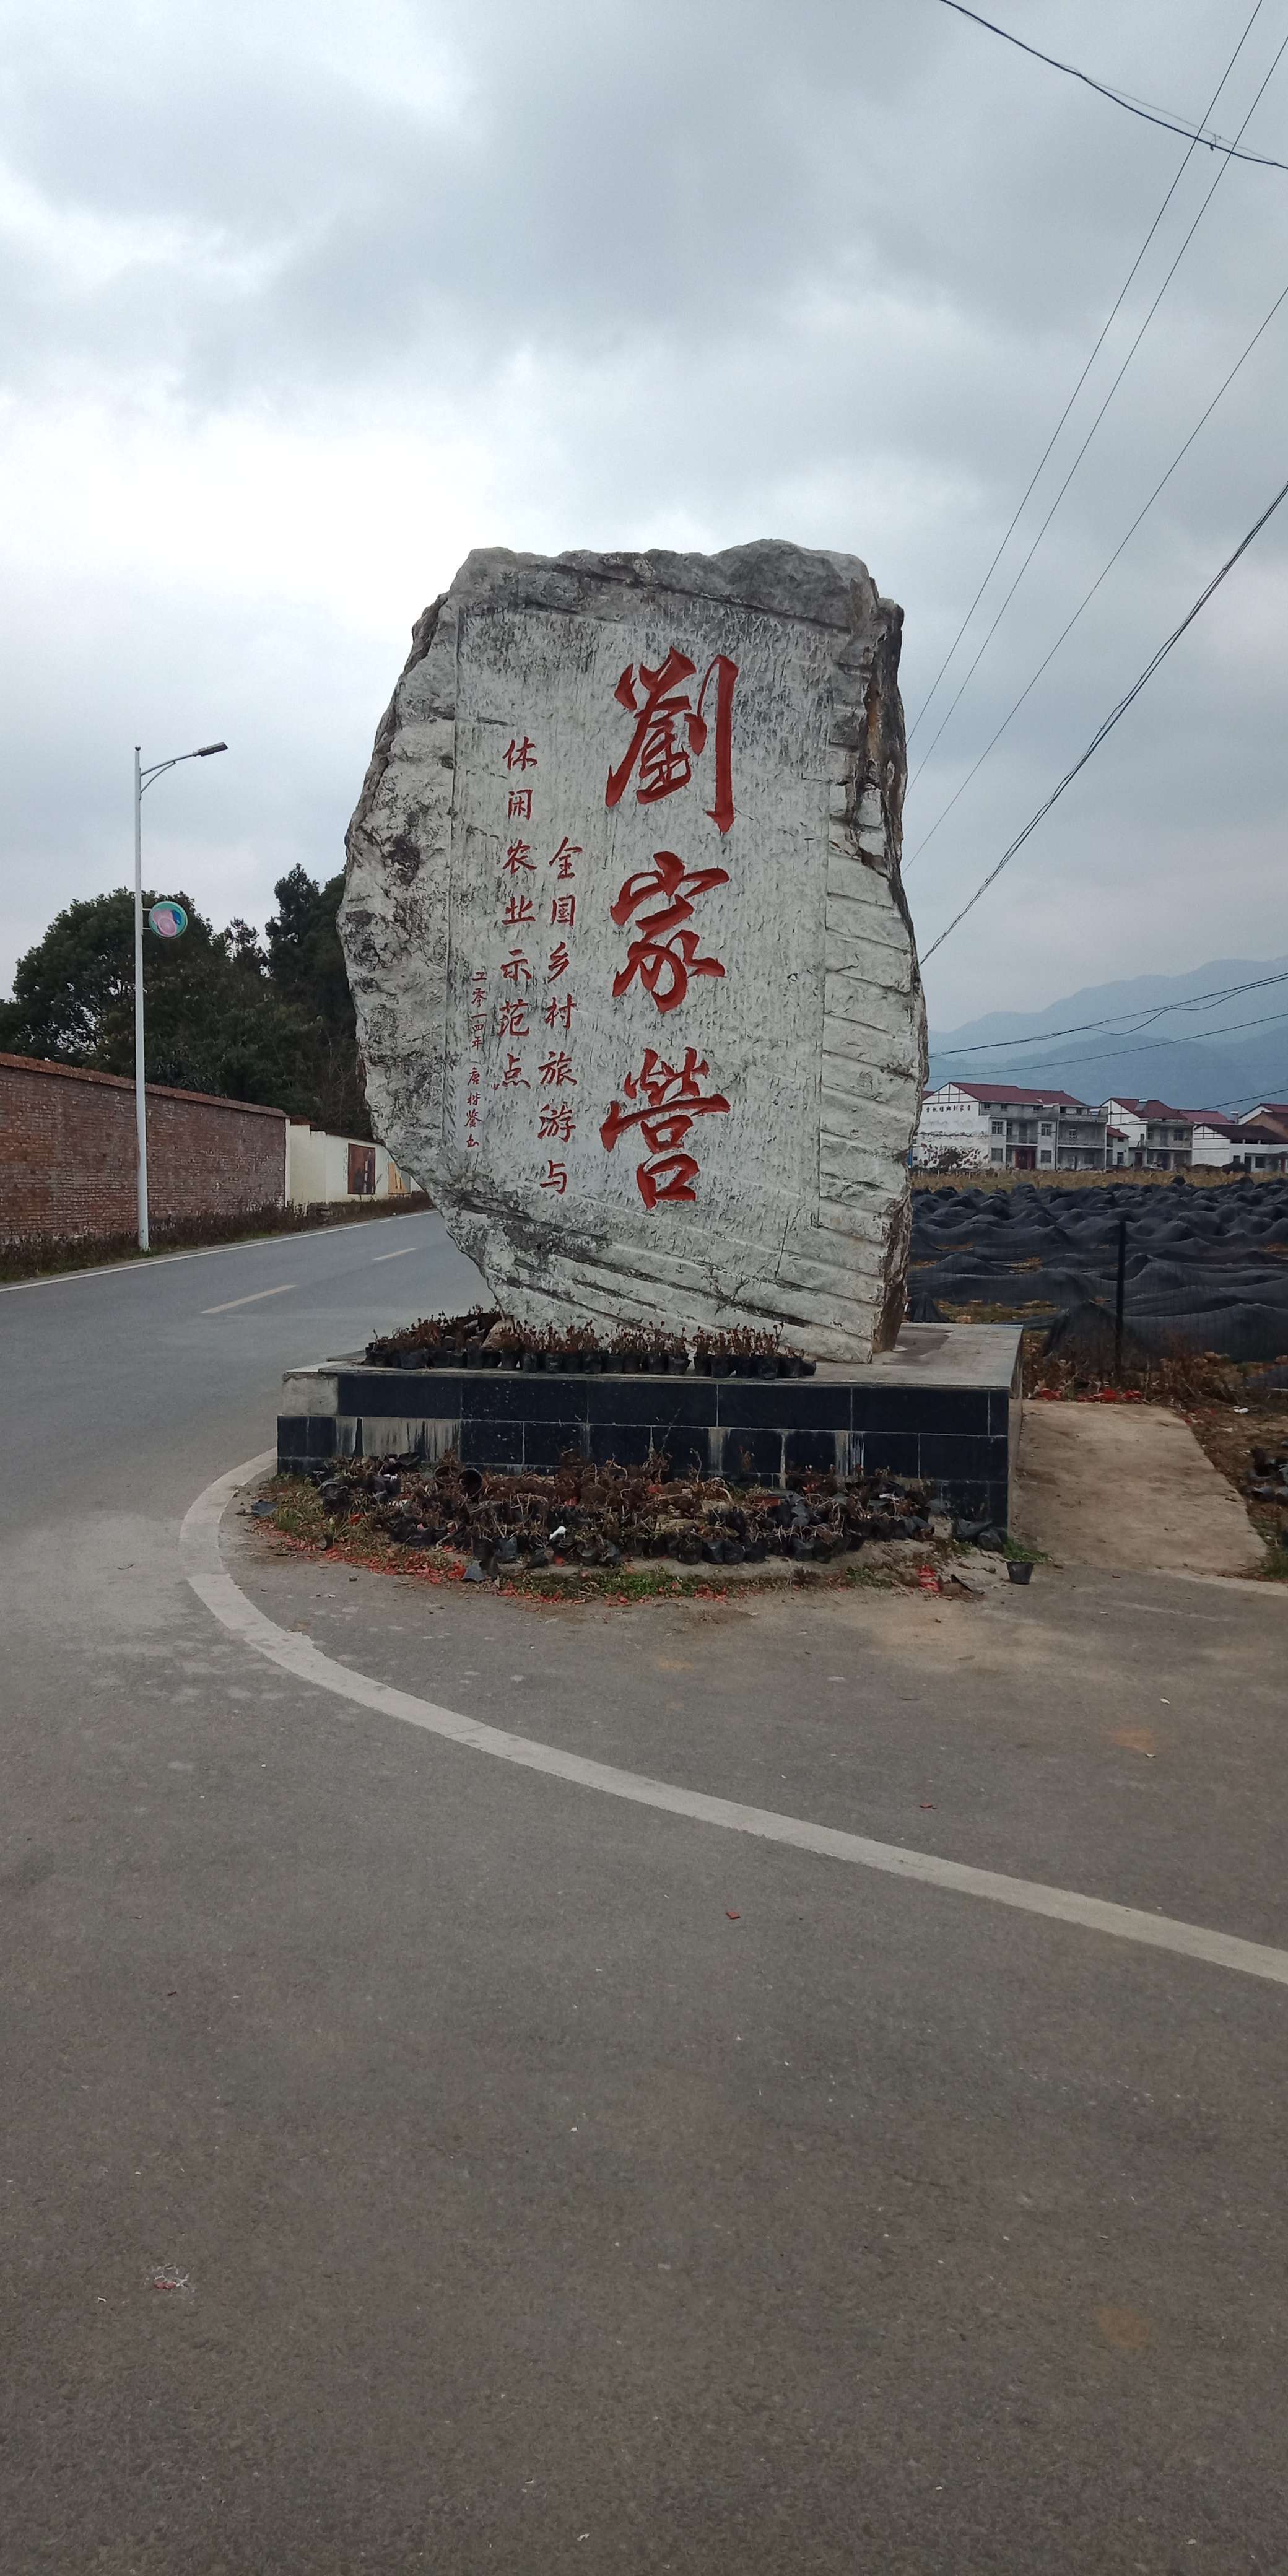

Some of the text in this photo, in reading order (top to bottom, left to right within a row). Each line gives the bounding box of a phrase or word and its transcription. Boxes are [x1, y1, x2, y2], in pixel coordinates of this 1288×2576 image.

[498, 736, 537, 1089] 休闲农业示范点
[537, 837, 583, 1194] 全国乡村旅游与
